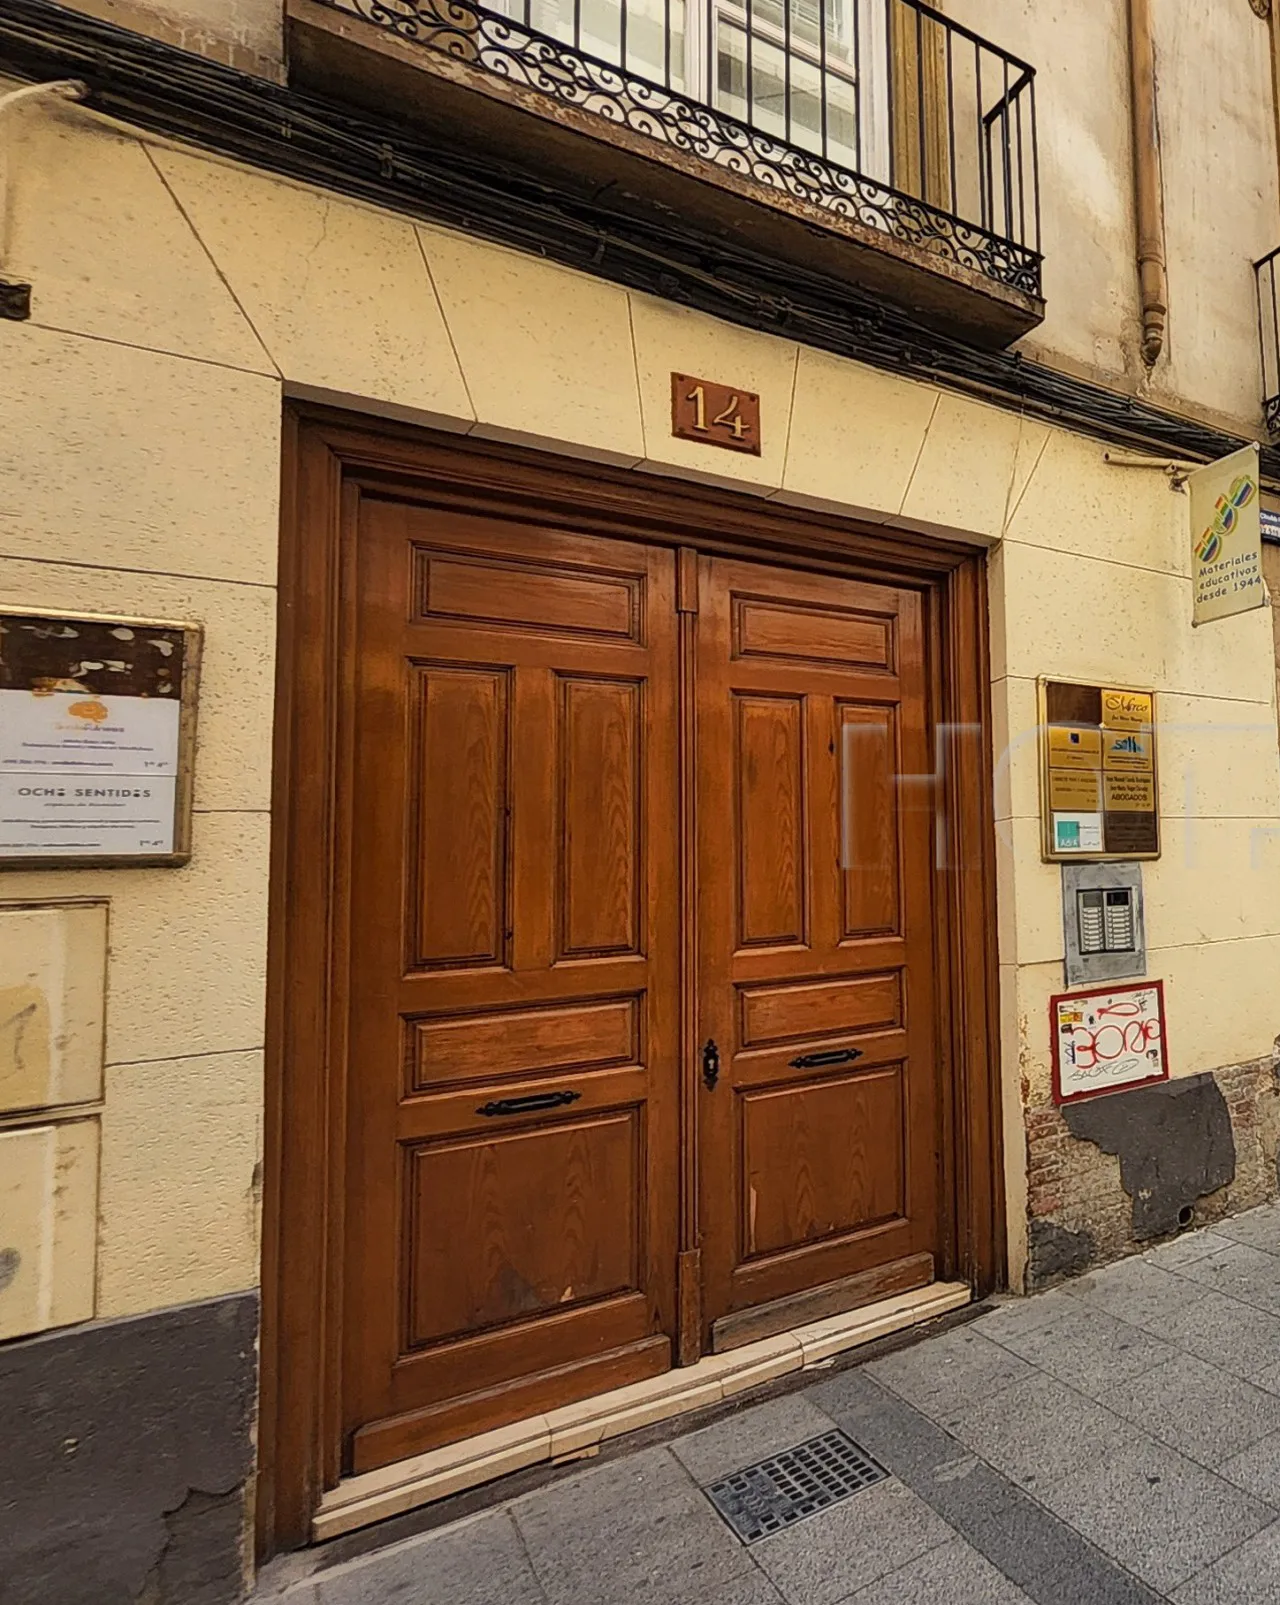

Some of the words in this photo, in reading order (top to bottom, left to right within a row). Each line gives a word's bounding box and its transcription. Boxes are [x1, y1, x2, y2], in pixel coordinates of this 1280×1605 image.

[686, 386, 751, 440] 14
[1199, 552, 1258, 578] Materiales
[1200, 565, 1258, 590] educativos
[1196, 585, 1228, 603] desde
[1233, 575, 1262, 593] 1944
